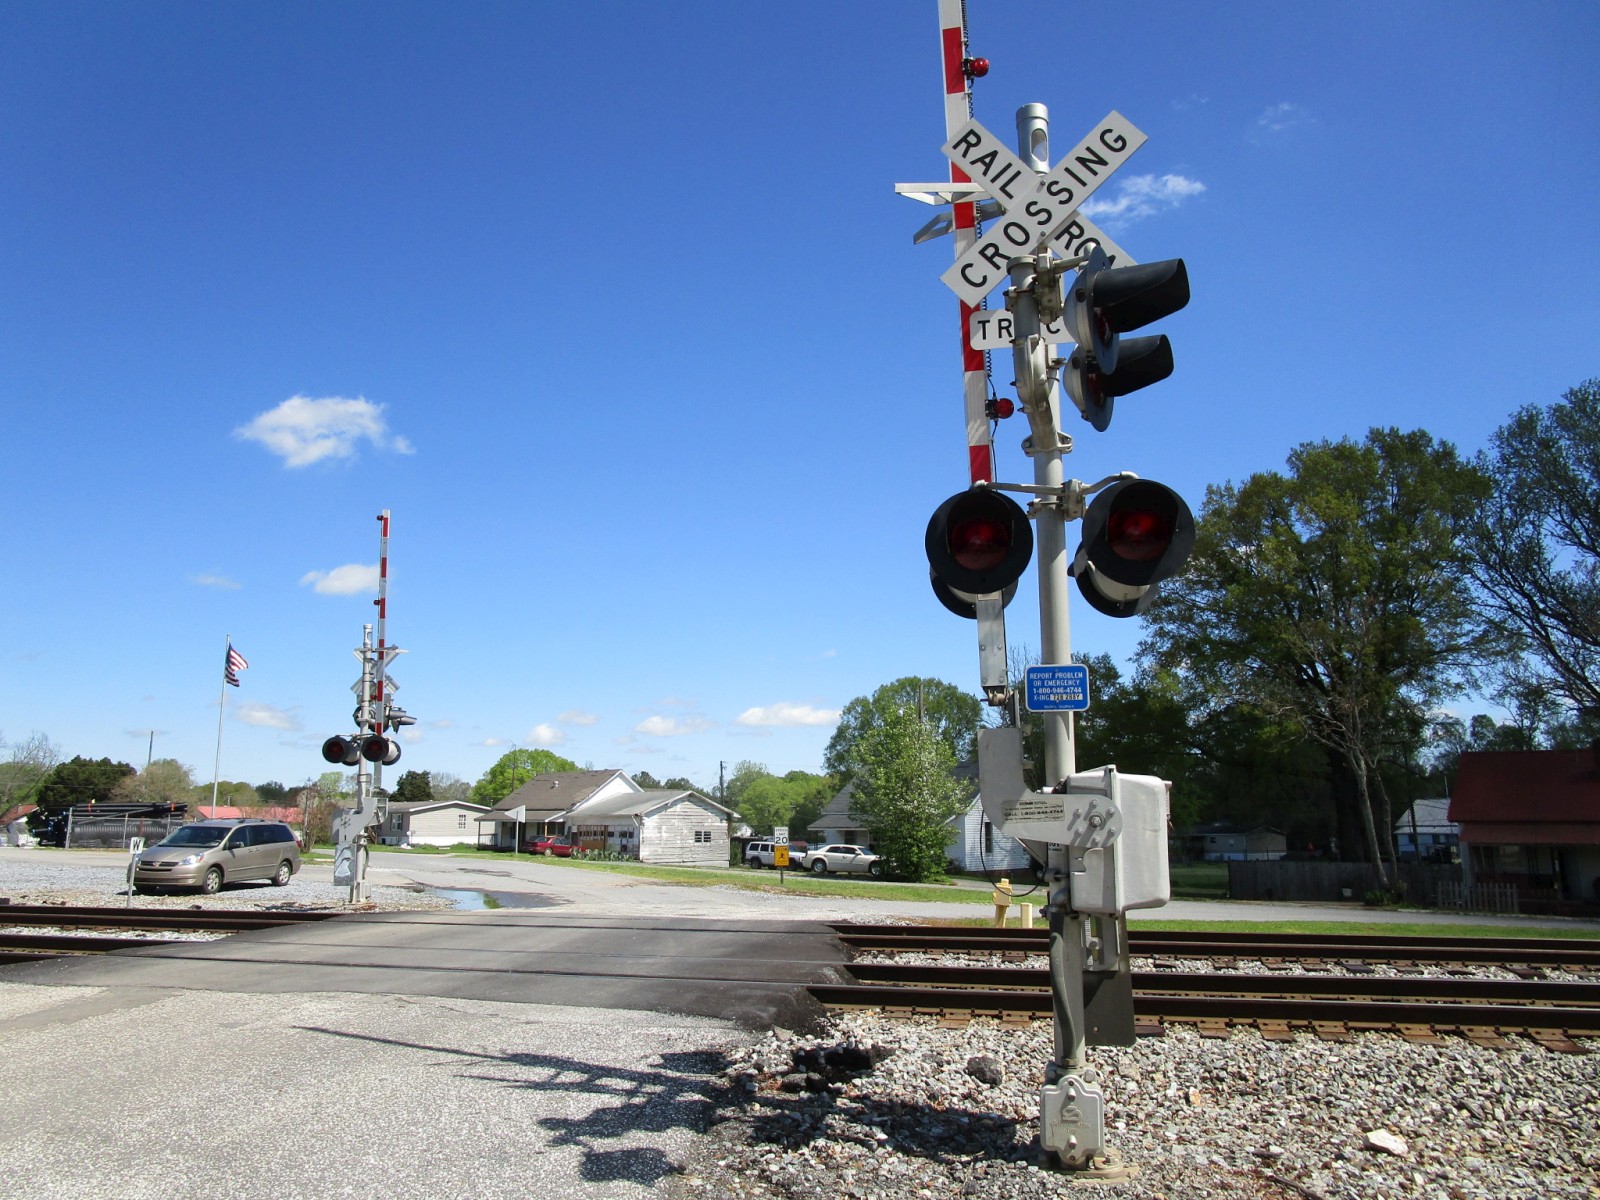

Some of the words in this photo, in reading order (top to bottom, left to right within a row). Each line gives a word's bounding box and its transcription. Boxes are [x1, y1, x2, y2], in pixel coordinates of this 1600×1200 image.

[952, 128, 1022, 199] RAIL
[960, 128, 1128, 288] CROSSING
[133, 839, 141, 850] W
[776, 836, 788, 844] 20
